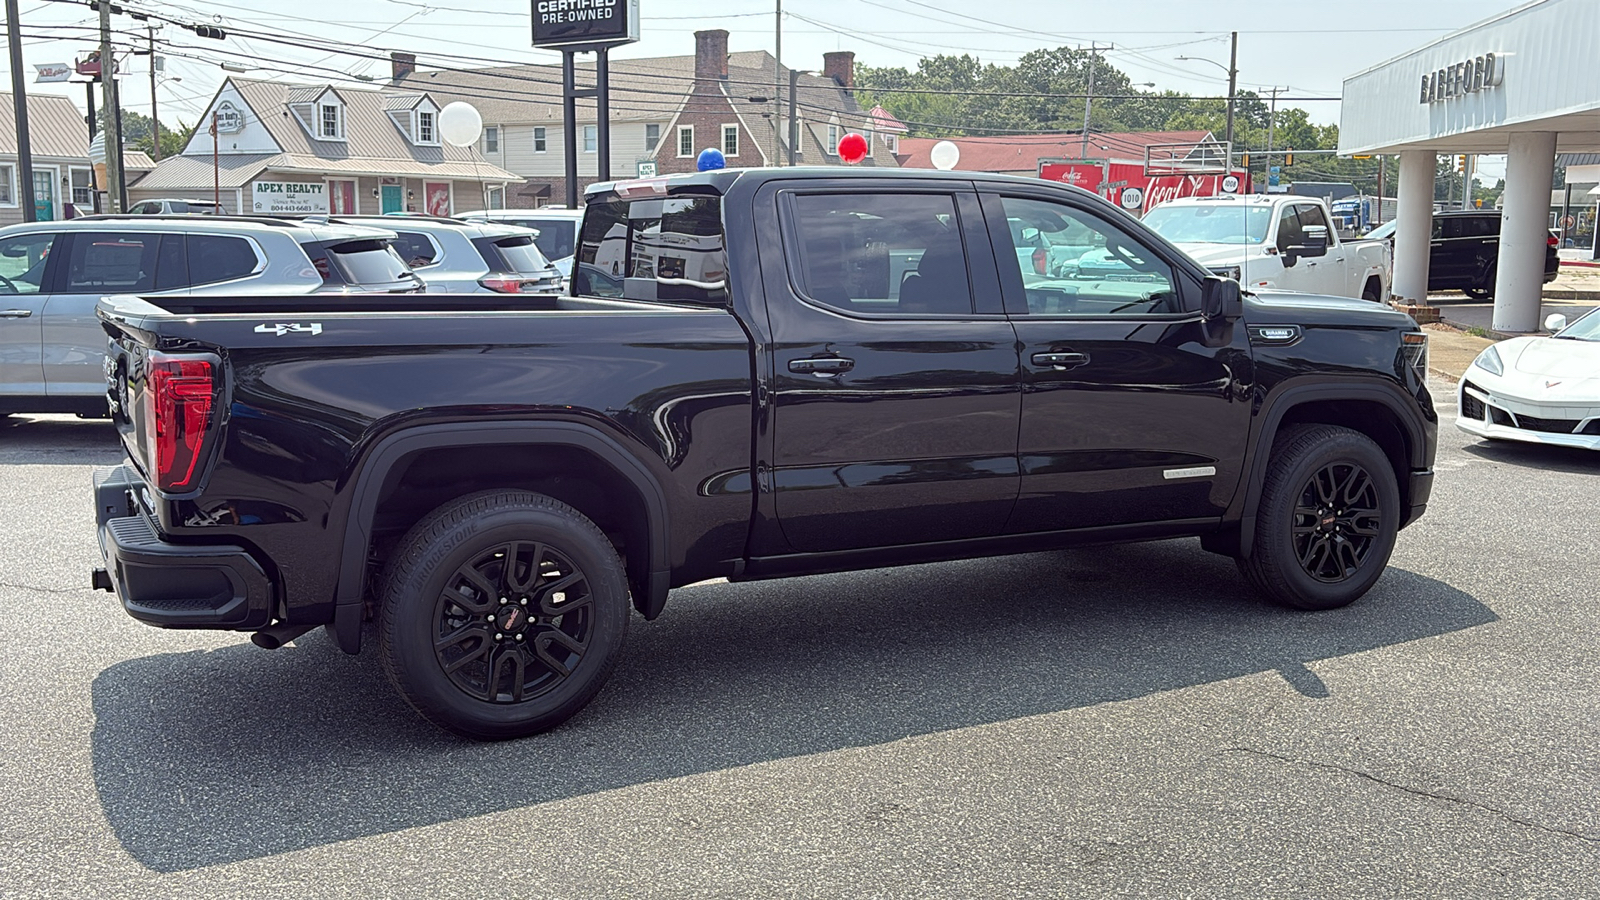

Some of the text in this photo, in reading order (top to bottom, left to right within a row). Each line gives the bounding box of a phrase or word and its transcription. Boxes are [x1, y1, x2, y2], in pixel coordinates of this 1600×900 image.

[538, 0, 617, 12] CERTIFIED
[542, 8, 613, 24] PRE-OWNED
[1420, 52, 1503, 104] BAREFORD
[257, 183, 323, 194] APEX REALTY
[1123, 194, 1140, 203] 1010
